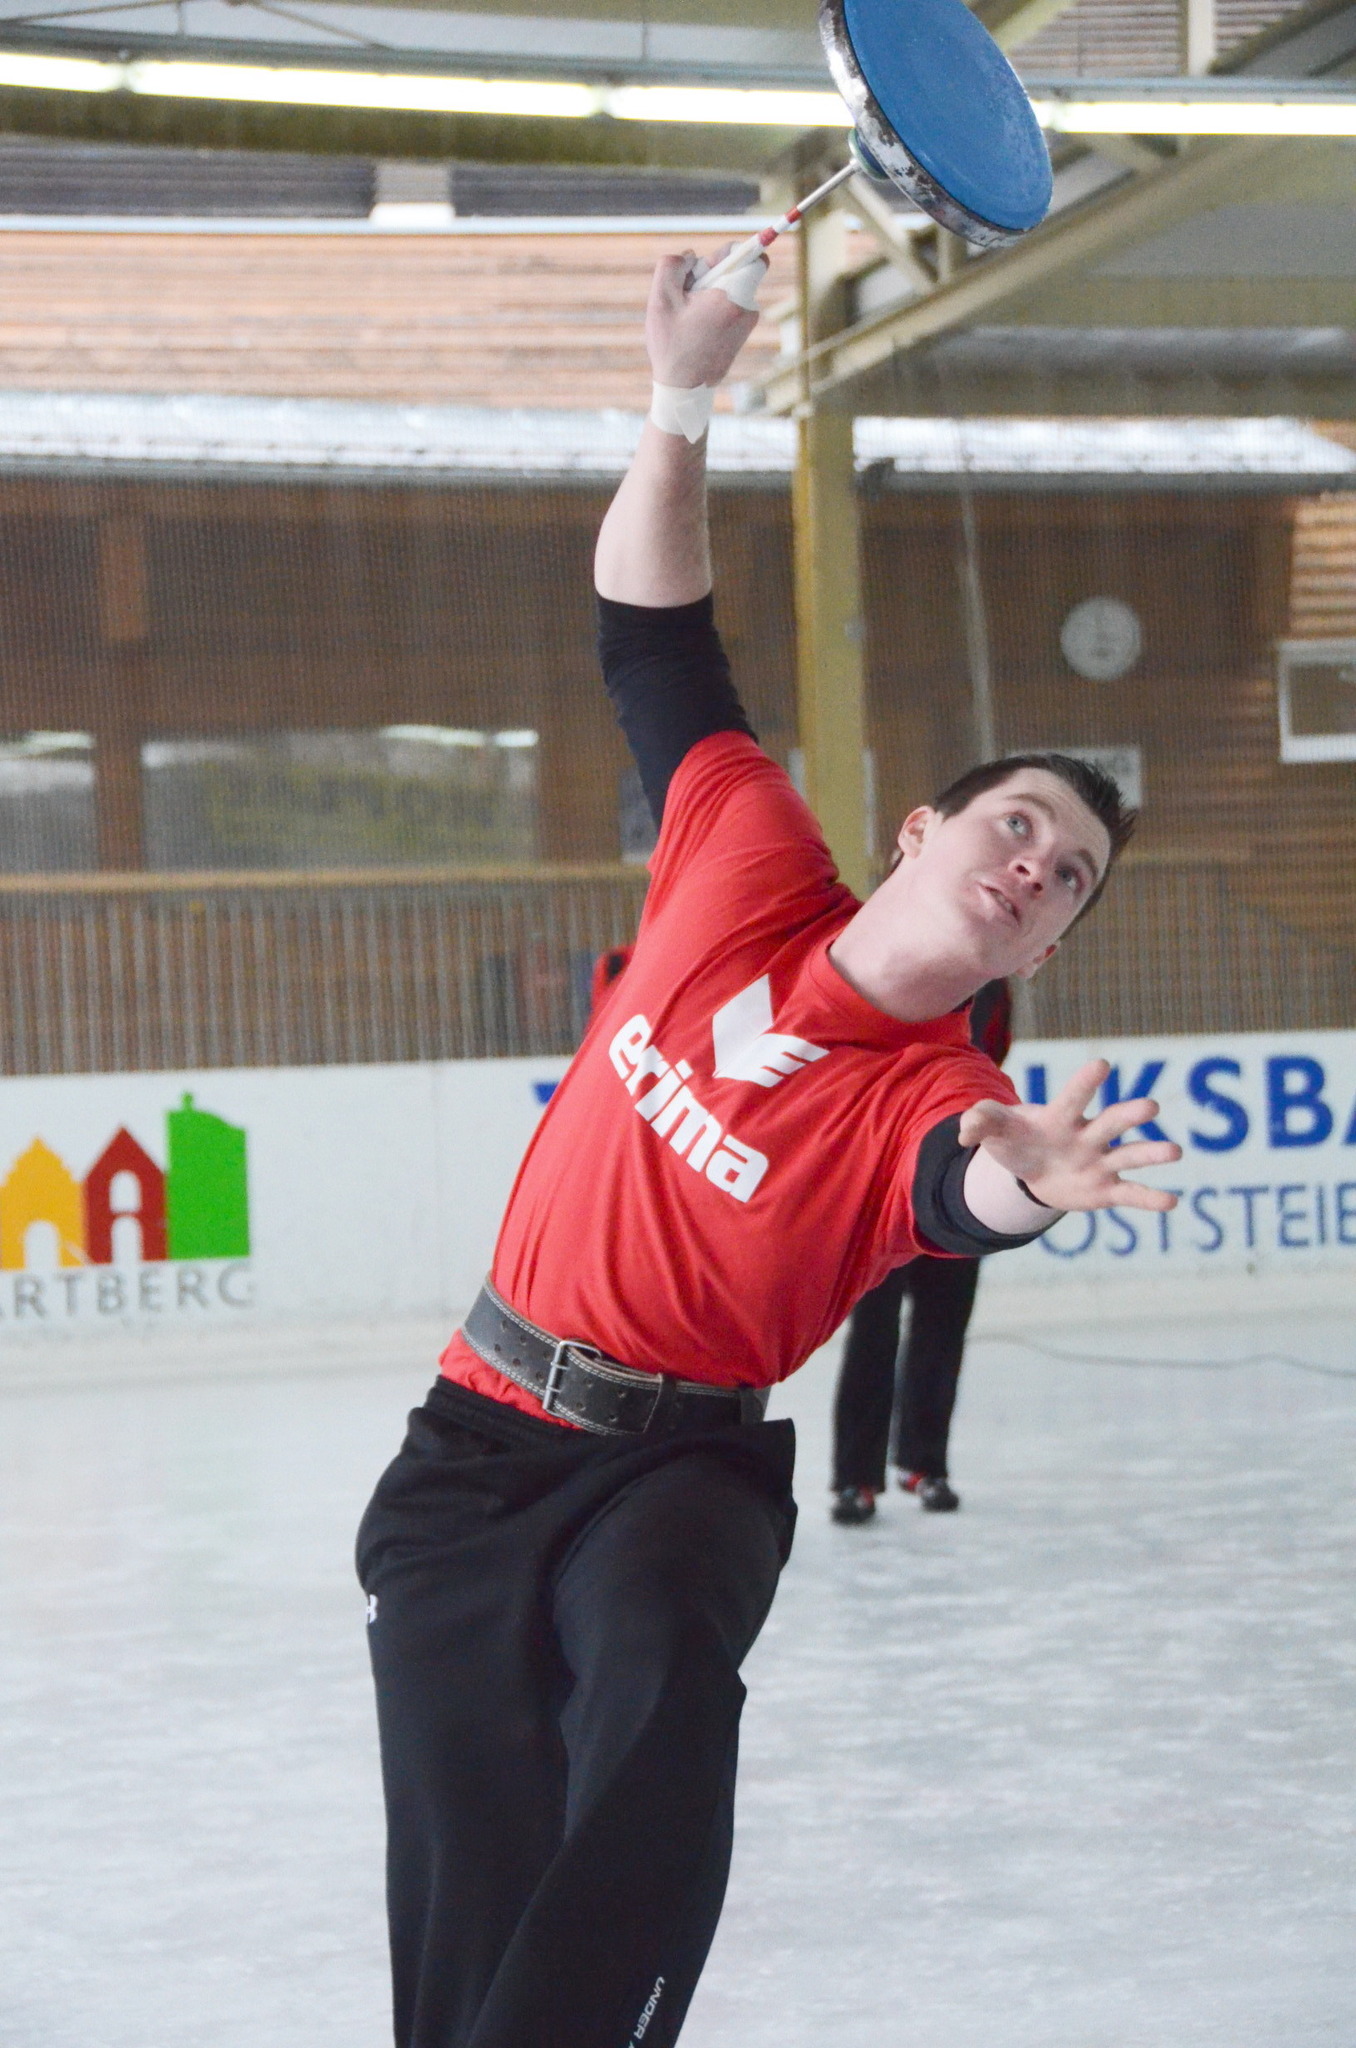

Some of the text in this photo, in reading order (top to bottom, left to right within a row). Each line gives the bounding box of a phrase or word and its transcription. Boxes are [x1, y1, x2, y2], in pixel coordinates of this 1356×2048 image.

[609, 1014, 769, 1203] erima
[1026, 1056, 1356, 1152] KSB
[0, 1262, 256, 1319] RTBERG
[633, 1976, 665, 2039] UNDER
